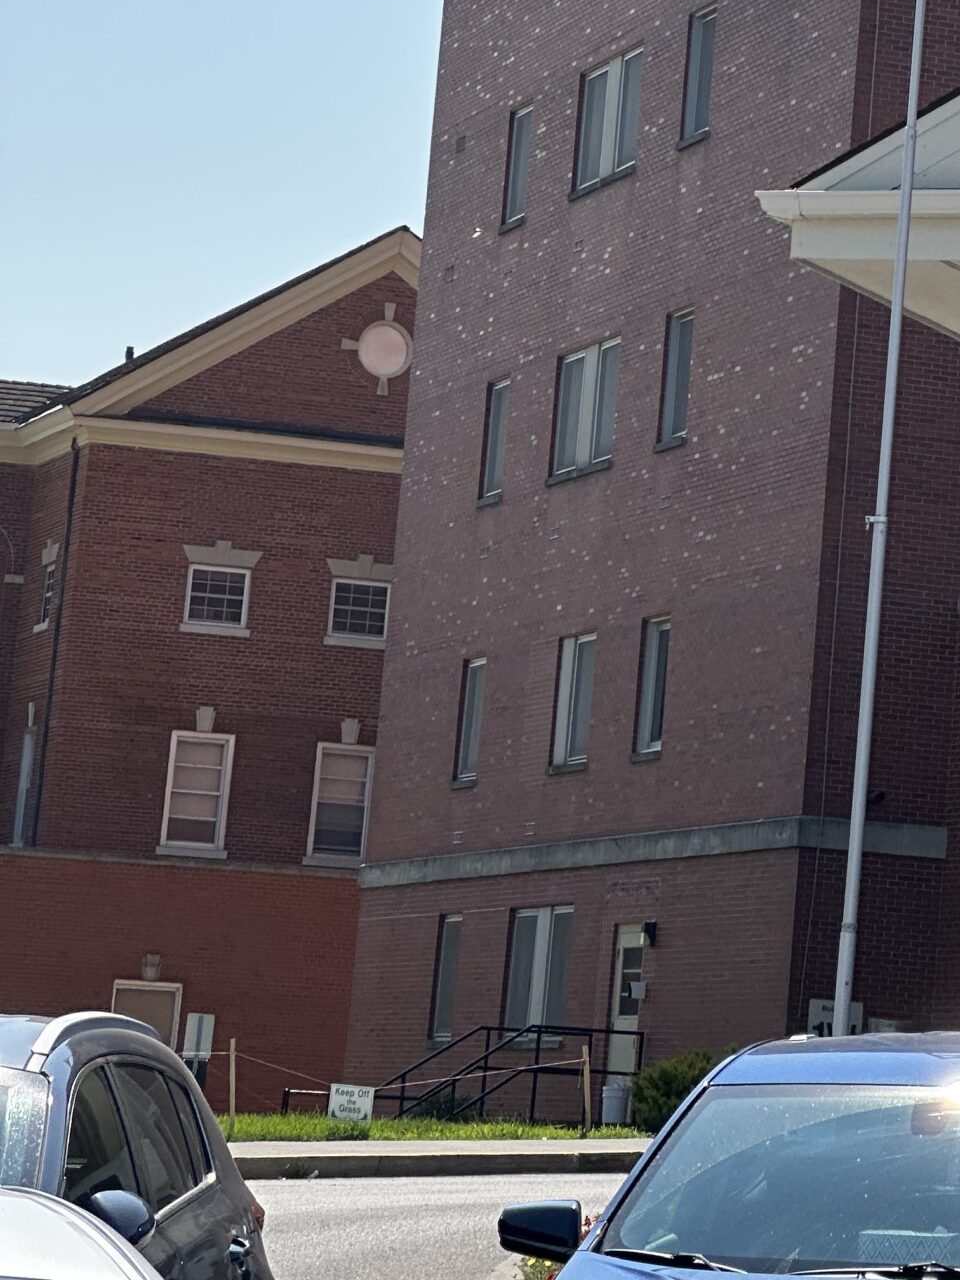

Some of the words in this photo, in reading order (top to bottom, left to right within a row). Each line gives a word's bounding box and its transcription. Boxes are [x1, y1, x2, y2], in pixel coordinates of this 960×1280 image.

[335, 1087, 355, 1097] Keep
[357, 1089, 370, 1098] Off
[338, 1104, 361, 1114] Grass
